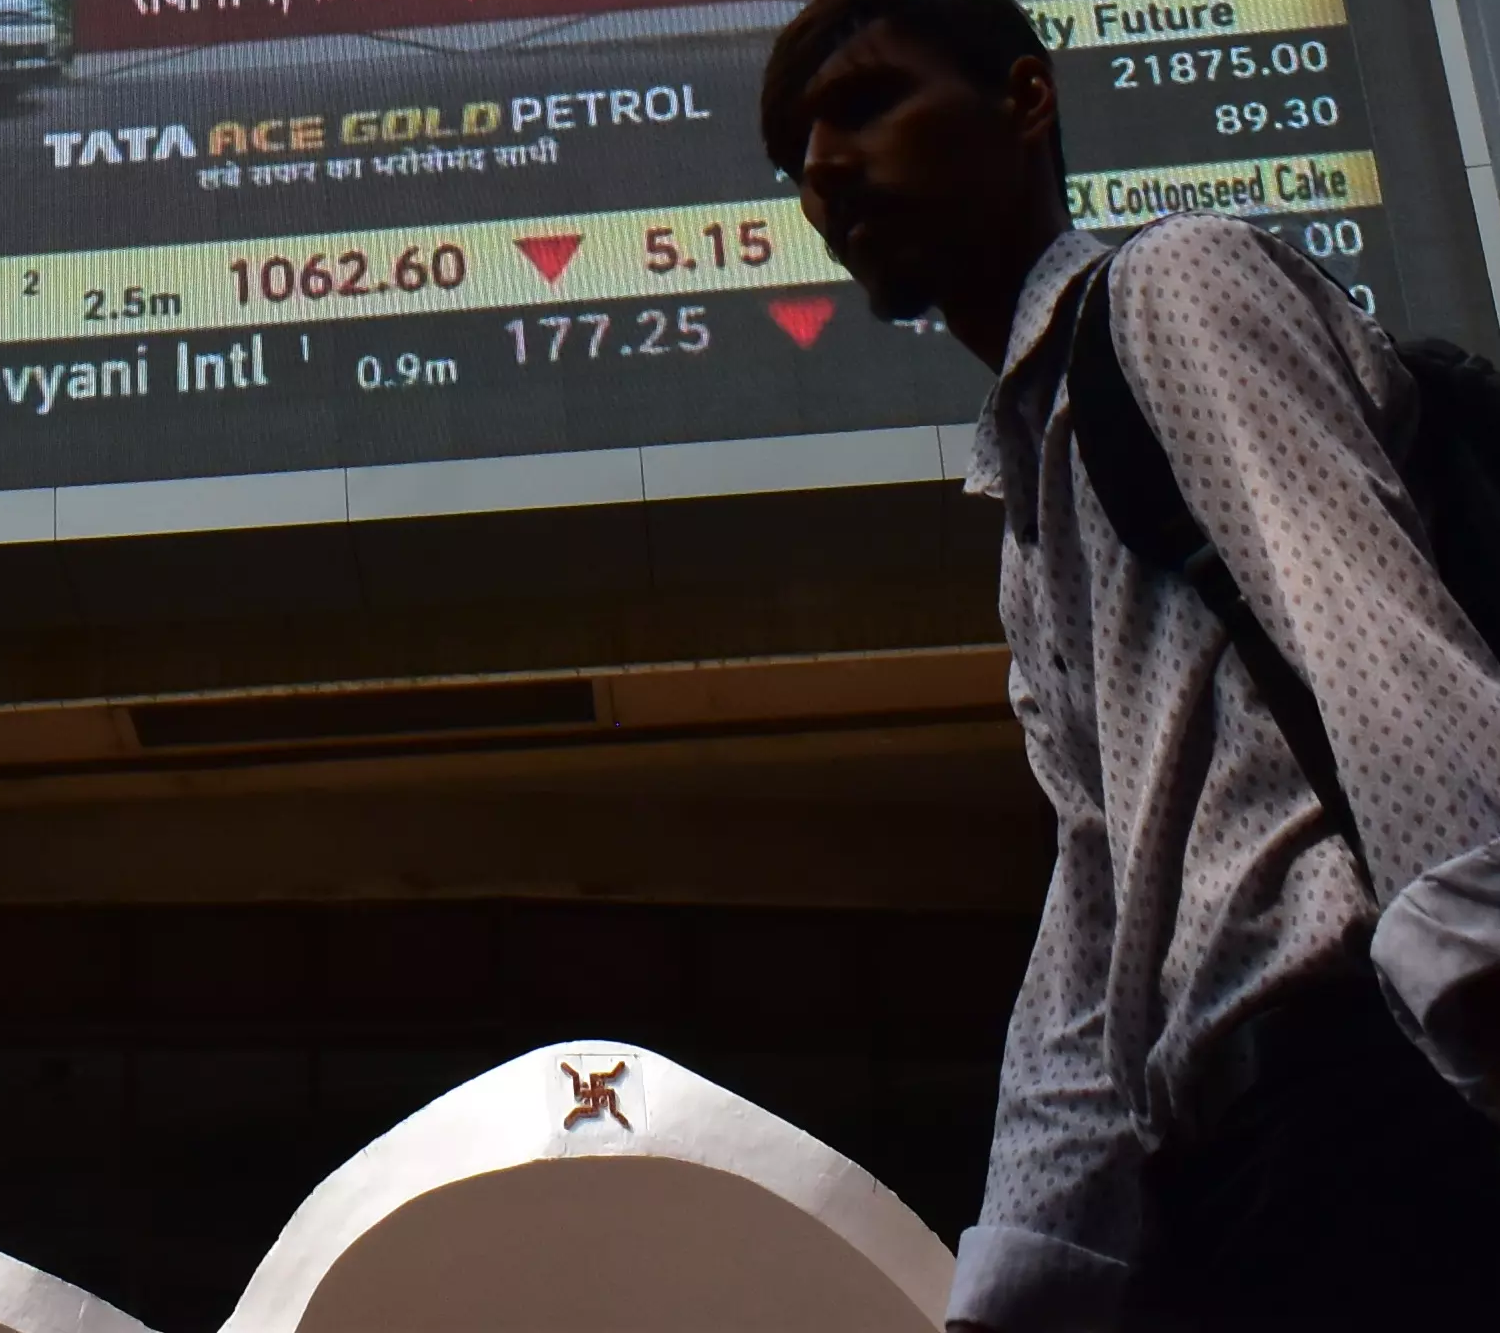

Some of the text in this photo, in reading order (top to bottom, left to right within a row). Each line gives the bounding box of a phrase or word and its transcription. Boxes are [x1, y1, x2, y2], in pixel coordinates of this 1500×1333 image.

[1094, 0, 1236, 38] Future
[1110, 39, 1329, 90] 21875.00
[44, 83, 712, 168] TATA ACE GOLD PETROL
[1214, 95, 1339, 135] 89.30
[1106, 165, 1266, 215] Cottonseed
[1274, 159, 1348, 203] Cake
[22, 270, 41, 296] 2
[83, 288, 183, 322] 2.5m
[229, 243, 467, 305] 1062.60
[644, 219, 773, 273] 5.15
[175, 333, 268, 394] Intl
[357, 353, 460, 391] 0.9m
[504, 305, 712, 366] 177.25
